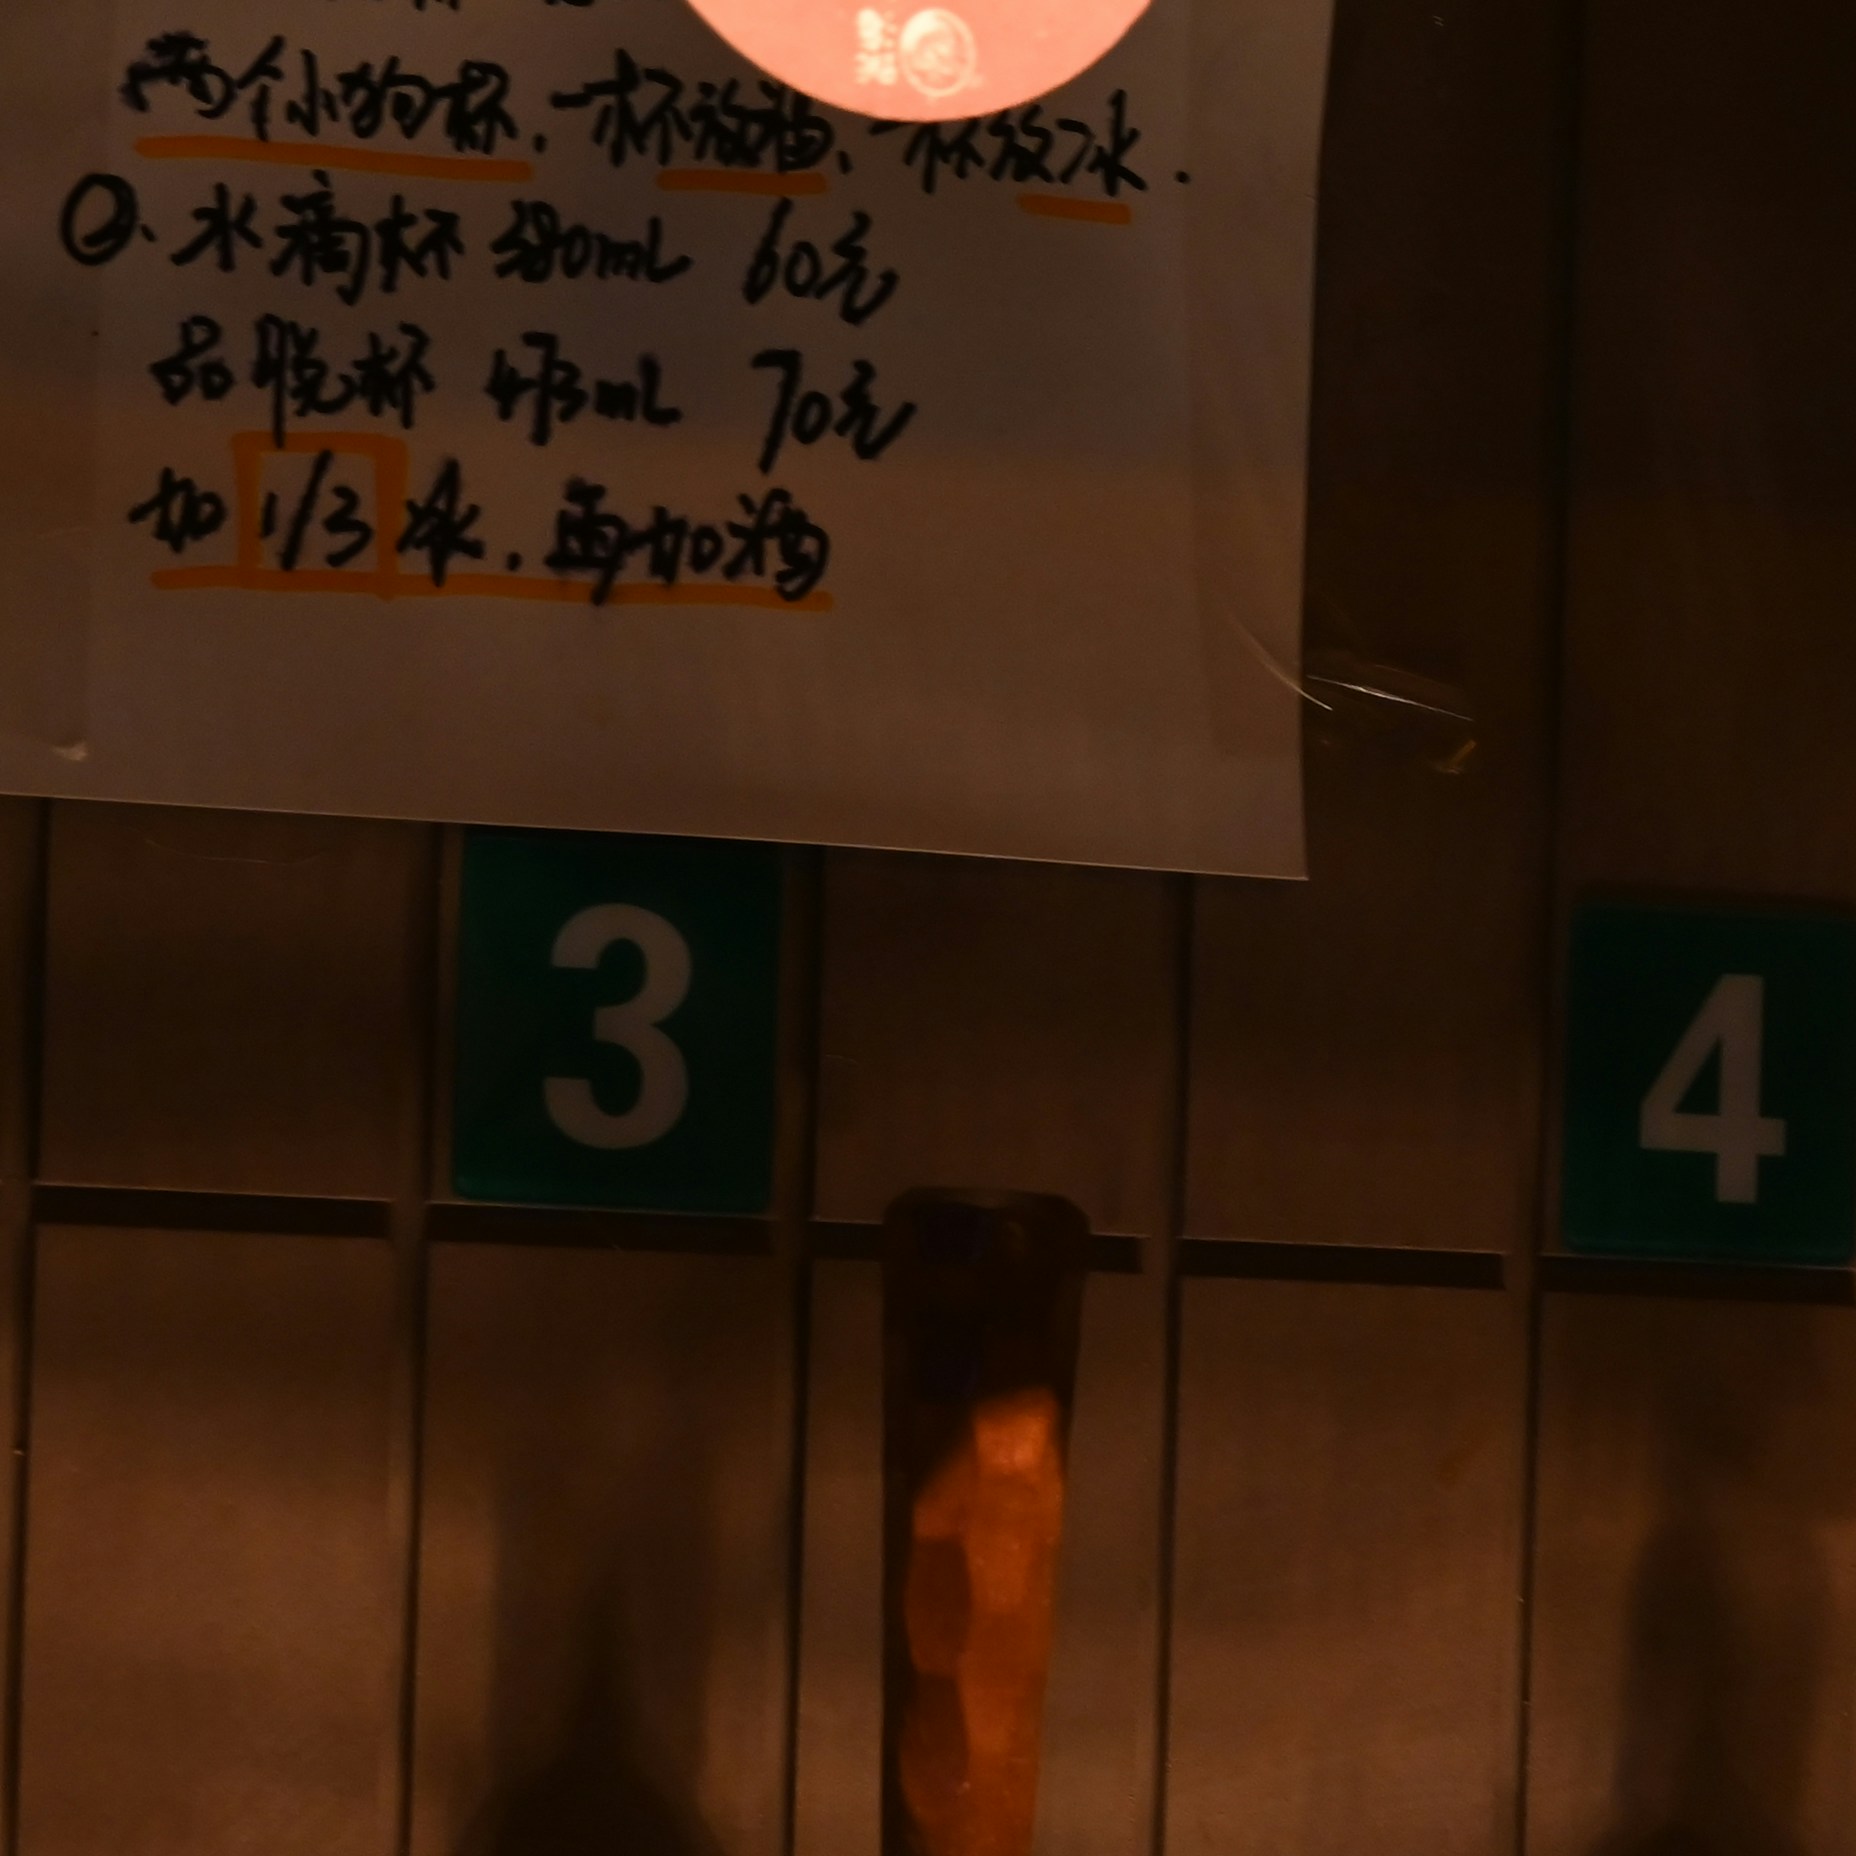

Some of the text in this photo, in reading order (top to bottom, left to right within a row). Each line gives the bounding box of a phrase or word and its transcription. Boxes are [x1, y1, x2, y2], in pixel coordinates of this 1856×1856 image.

[744, 200, 898, 322] 60元
[751, 349, 916, 473] 70元
[546, 904, 692, 1149] 3
[1639, 973, 1787, 1203] 4
